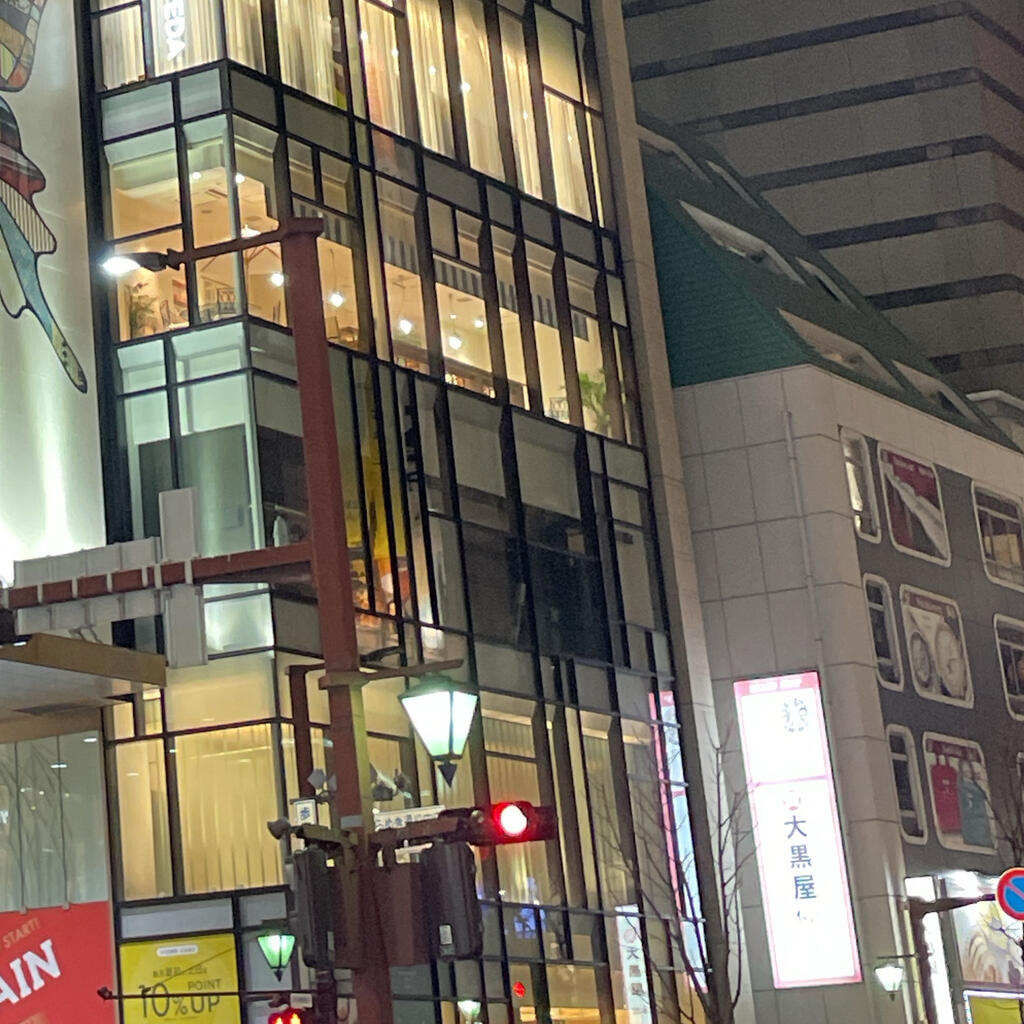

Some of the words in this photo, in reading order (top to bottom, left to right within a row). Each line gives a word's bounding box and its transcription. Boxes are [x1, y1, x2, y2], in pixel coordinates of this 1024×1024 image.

[784, 815, 818, 900] 大黒屋
[187, 979, 221, 991] POINT
